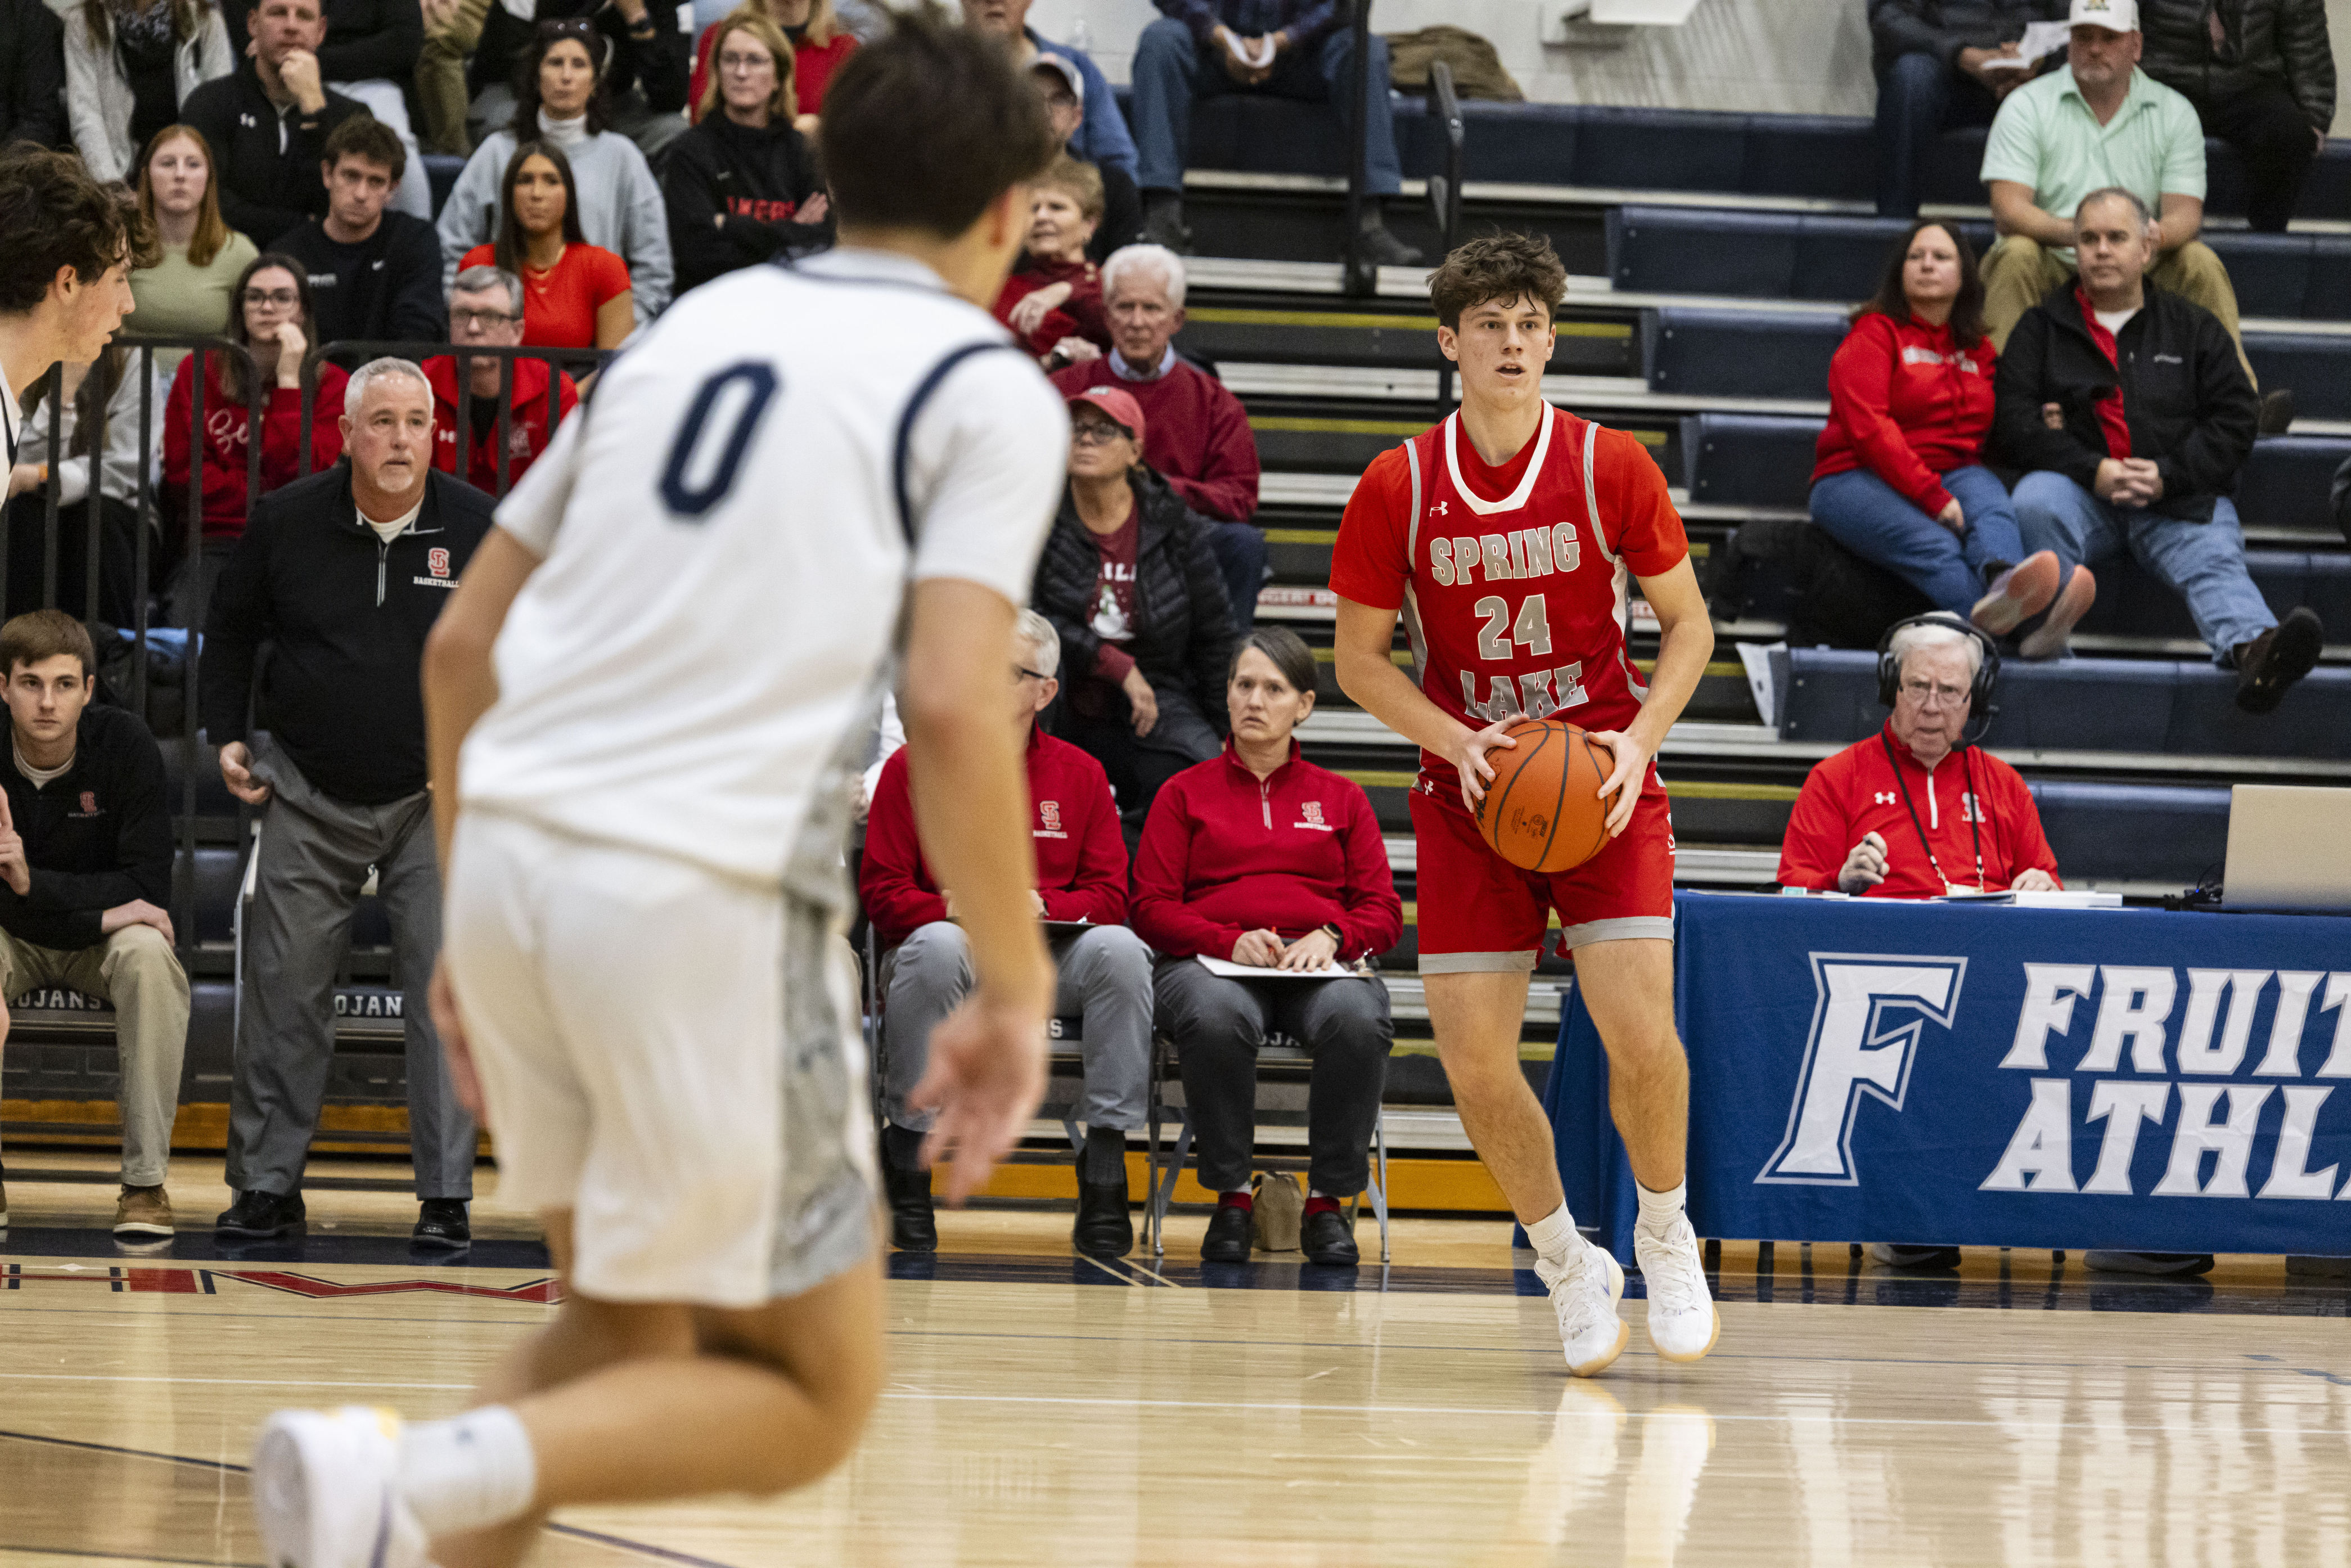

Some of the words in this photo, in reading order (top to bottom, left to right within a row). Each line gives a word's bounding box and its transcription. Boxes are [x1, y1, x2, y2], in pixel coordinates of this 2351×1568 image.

[658, 360, 778, 516] 0
[413, 575, 460, 588] BASKETBALL
[1430, 522, 1580, 586] SPRING
[1475, 593, 1552, 659] 24
[1461, 661, 1589, 722] LAKE
[1753, 952, 1968, 1187] F
[1978, 1078, 2351, 1200] ATHL
